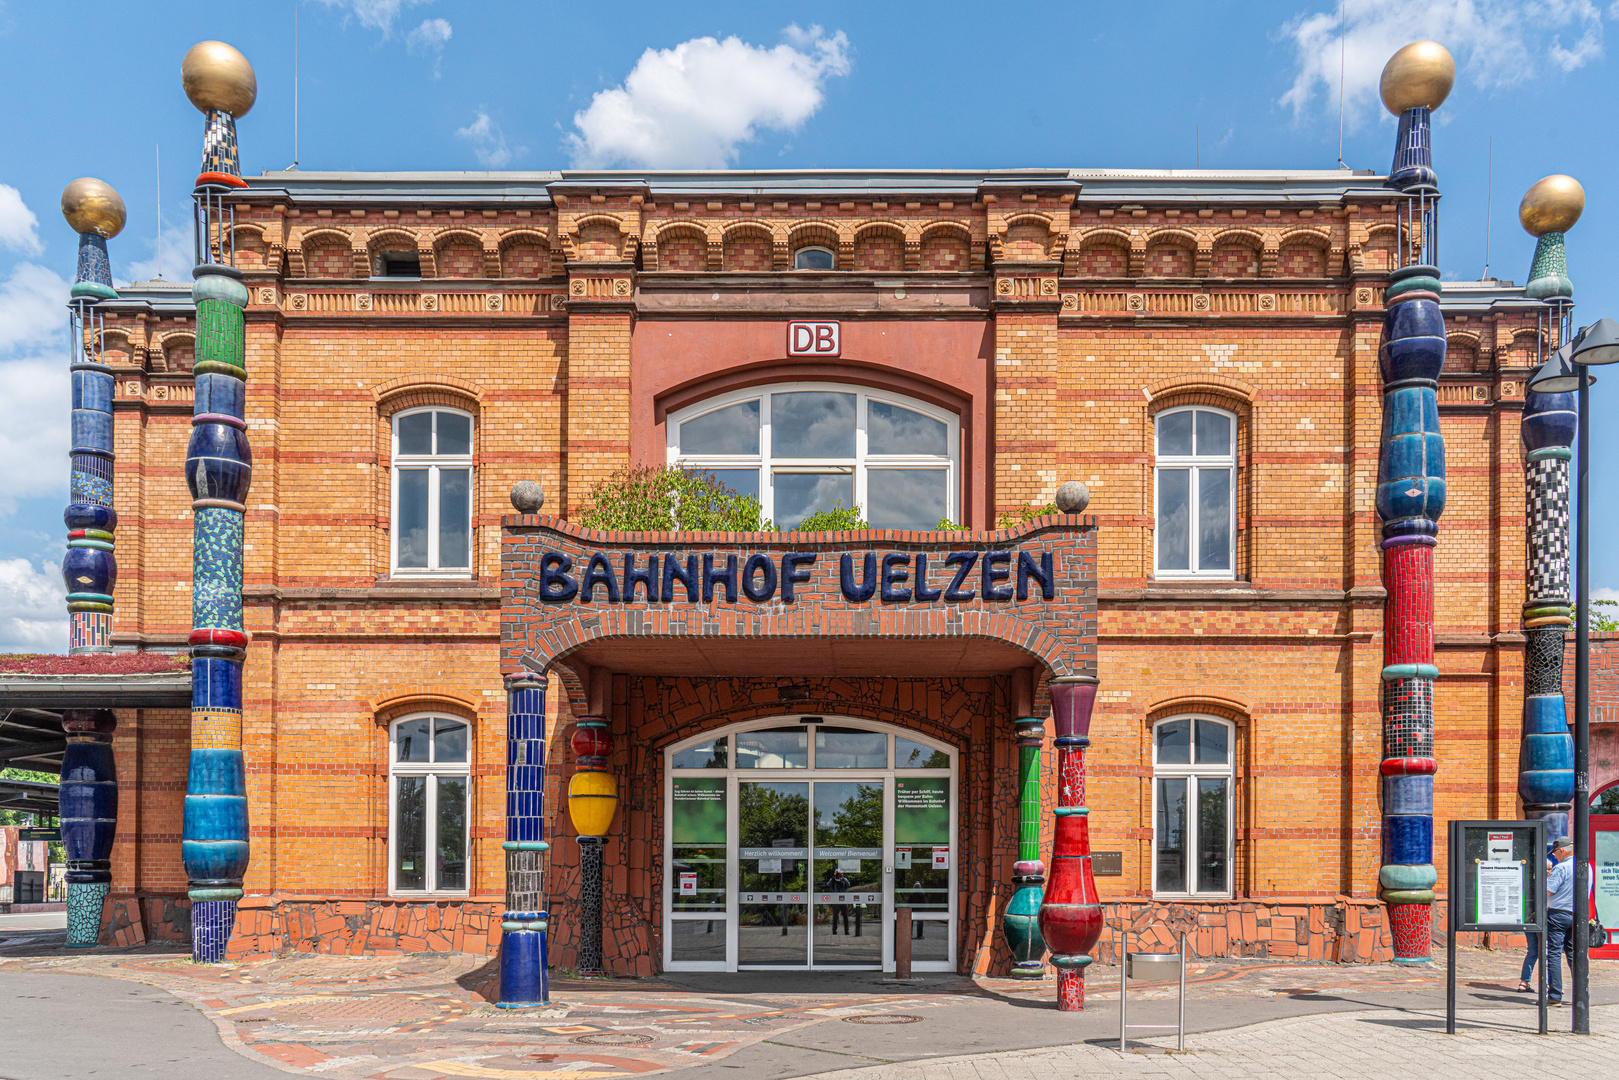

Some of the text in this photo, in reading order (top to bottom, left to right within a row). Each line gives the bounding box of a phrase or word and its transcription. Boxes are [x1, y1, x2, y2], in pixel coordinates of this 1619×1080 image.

[794, 325, 835, 352] DB
[539, 550, 1055, 602] BAHNHOF UELZEN
